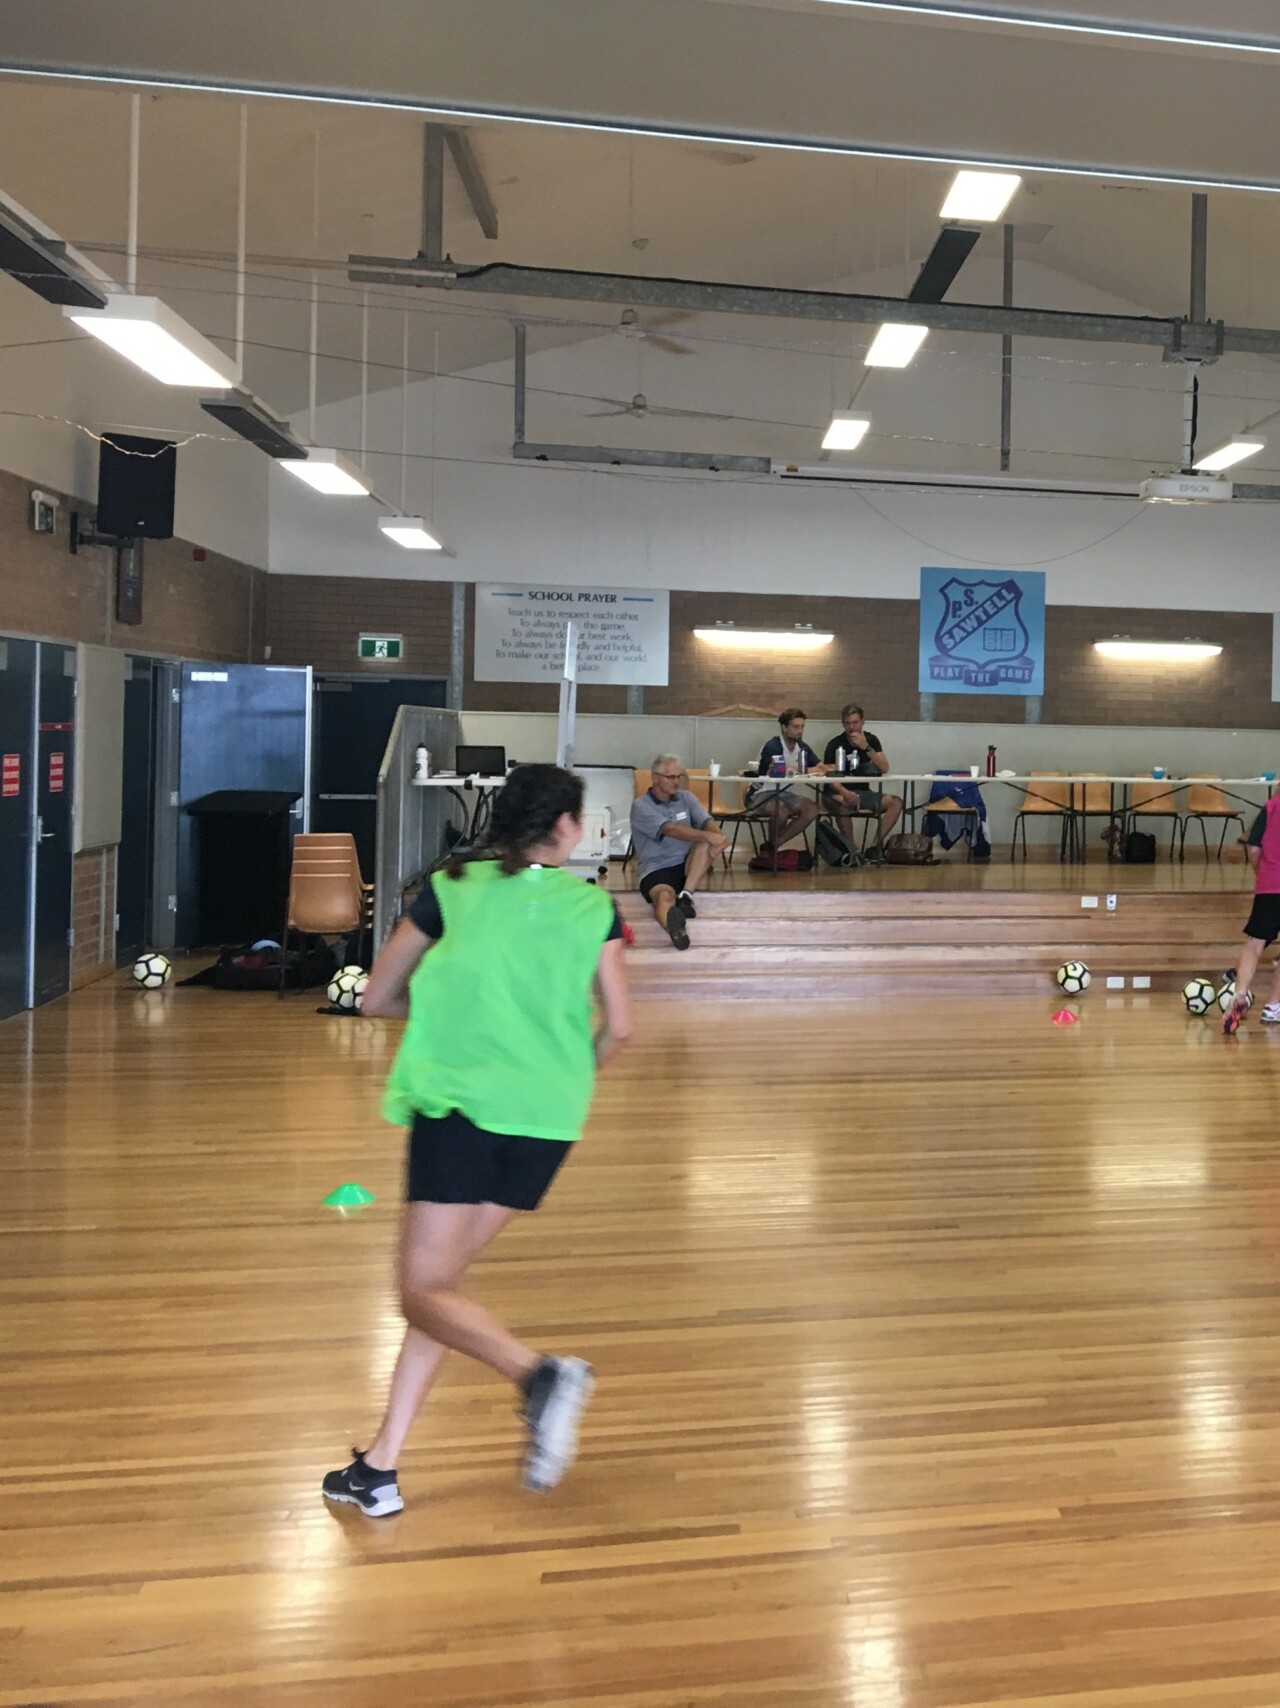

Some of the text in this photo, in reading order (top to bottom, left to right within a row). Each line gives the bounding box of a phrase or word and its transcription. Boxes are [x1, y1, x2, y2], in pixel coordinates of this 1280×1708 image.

[1179, 484, 1210, 493] EPSON
[528, 591, 617, 603] SCHOOL PRAYER
[507, 607, 531, 617] Teach
[533, 610, 544, 618] us
[547, 610, 556, 618] to
[558, 611, 589, 620] respect
[593, 611, 613, 620] each
[941, 588, 1015, 649] SAWTELL
[520, 618, 530, 627] To
[532, 619, 561, 629] always
[584, 620, 598, 629] the
[512, 628, 522, 638] To
[524, 630, 553, 640] always
[588, 632, 606, 640] best
[501, 639, 512, 648] To
[514, 640, 542, 650] always
[545, 640, 557, 649] be
[593, 642, 610, 651] and
[495, 649, 506, 659] To
[507, 650, 531, 660] make
[534, 652, 550, 660] our
[585, 652, 602, 661] and
[604, 654, 619, 662] our
[933, 667, 1031, 683] PLAY THE GAME
